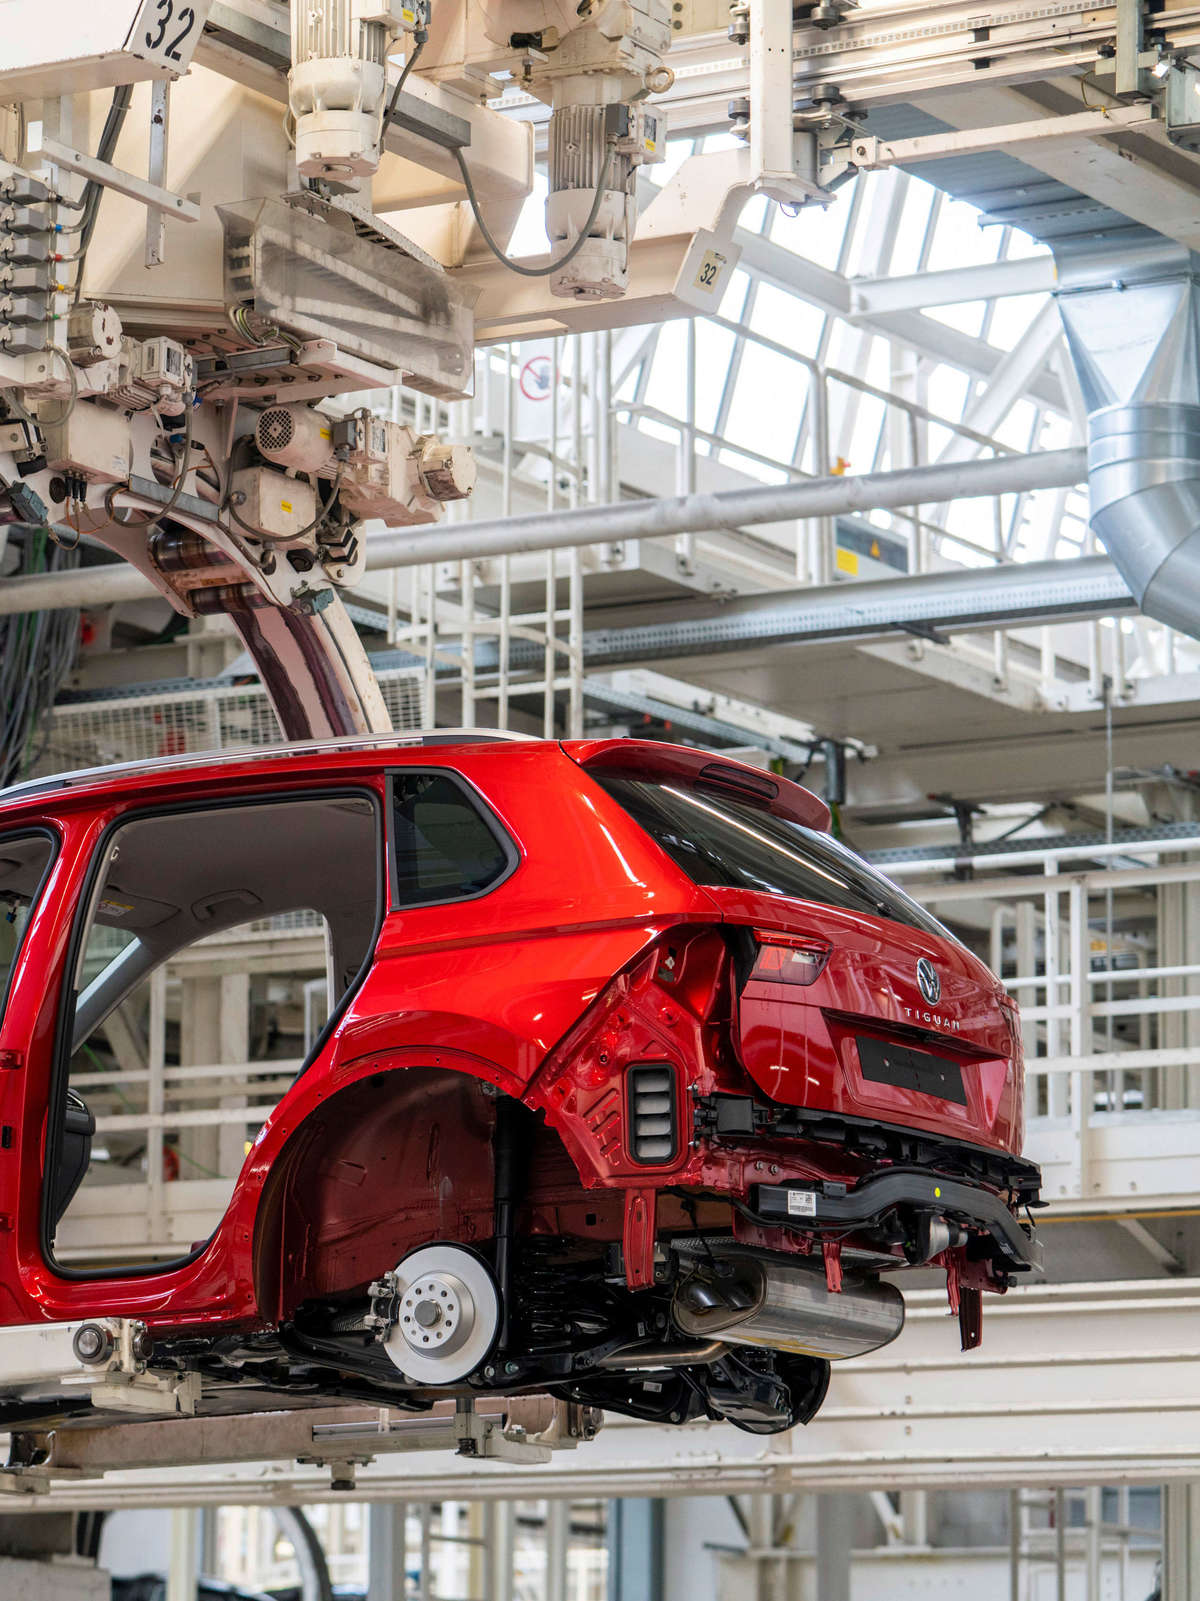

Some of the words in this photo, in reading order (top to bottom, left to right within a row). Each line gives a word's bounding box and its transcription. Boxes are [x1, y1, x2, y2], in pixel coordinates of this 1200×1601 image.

[145, 0, 195, 61] 32
[700, 263, 717, 285] 32
[904, 1007, 960, 1032] TIGUAN
